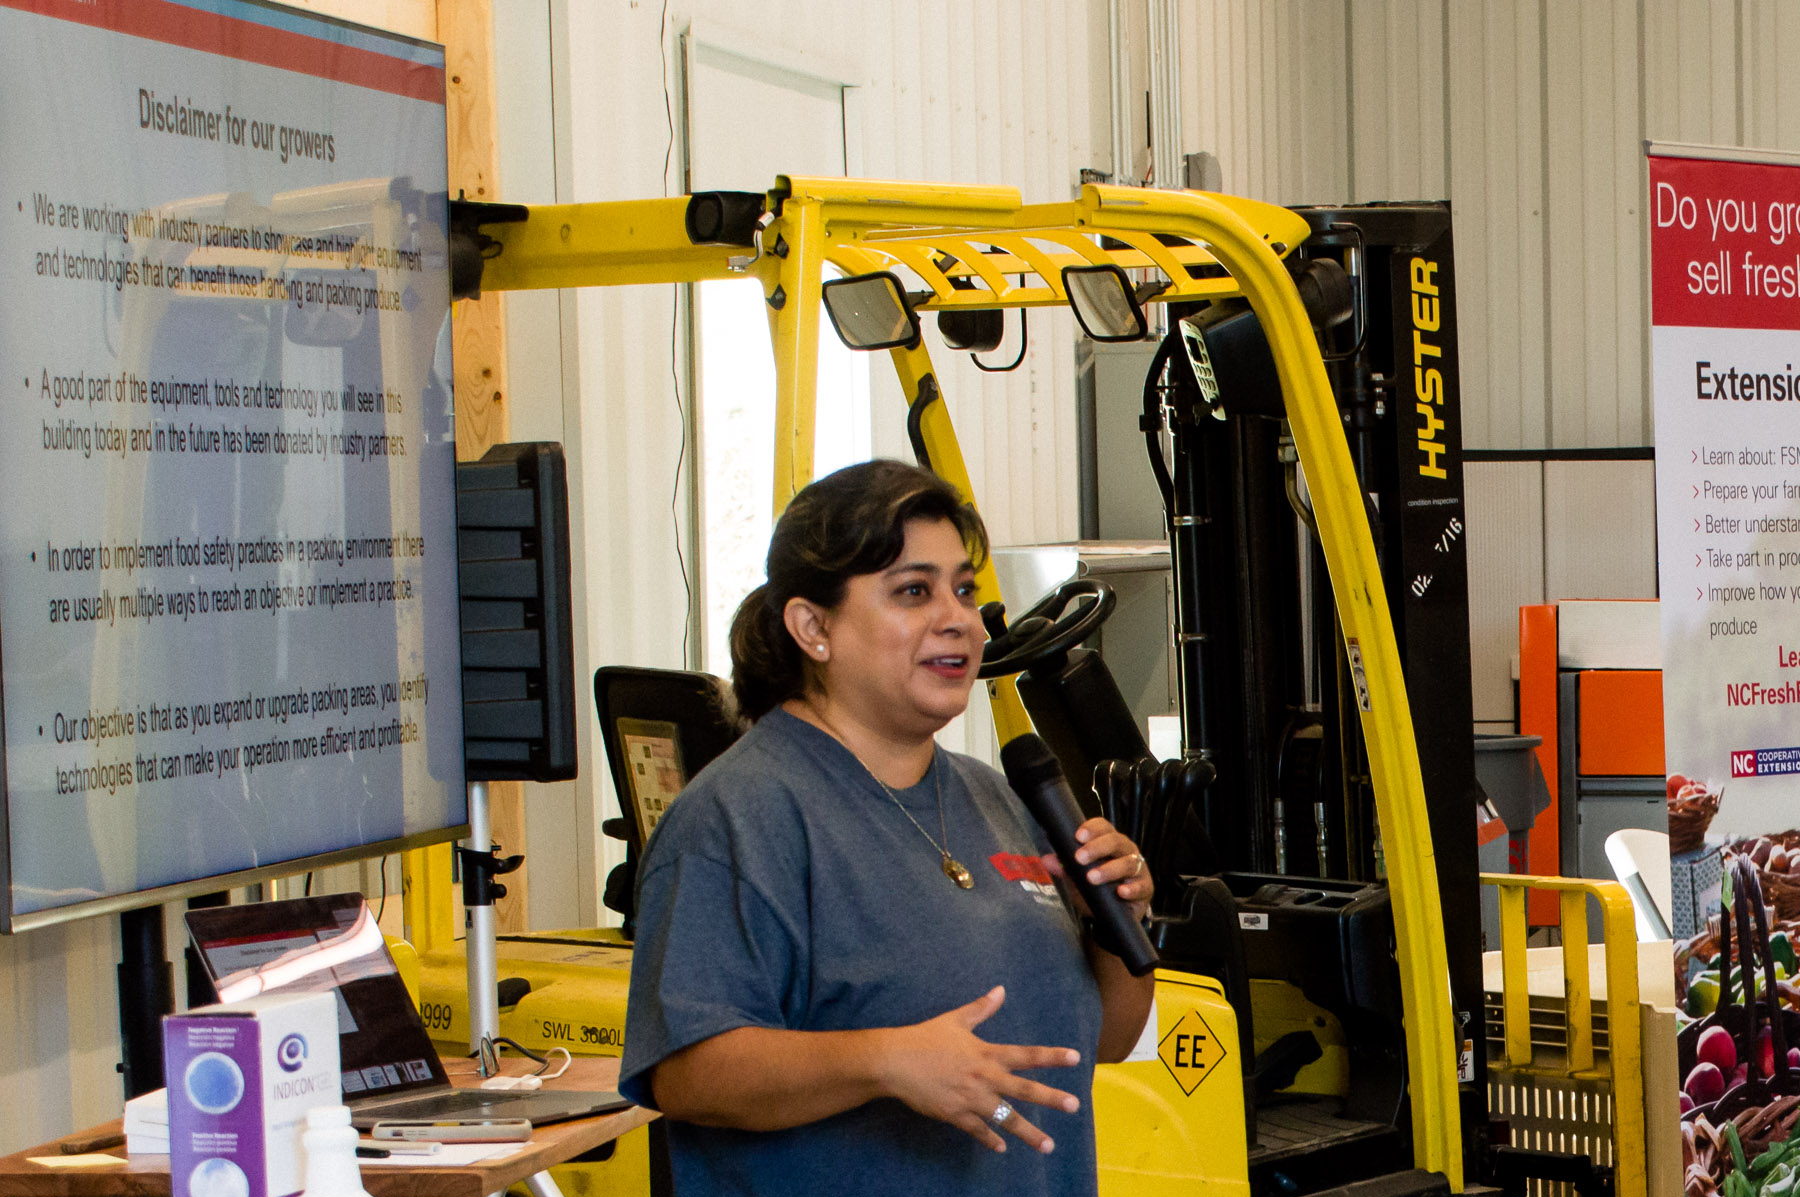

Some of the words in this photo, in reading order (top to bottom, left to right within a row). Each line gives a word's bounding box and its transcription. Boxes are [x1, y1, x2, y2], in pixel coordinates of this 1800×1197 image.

[139, 88, 222, 142] Disclaimer
[226, 105, 246, 146] for
[251, 120, 275, 151] our
[279, 125, 336, 164] growers
[33, 192, 55, 226] We
[59, 205, 79, 230] are
[83, 202, 129, 244] working
[132, 207, 156, 239] with
[205, 219, 249, 256] partners
[251, 223, 262, 251] to
[316, 234, 334, 261] and
[376, 244, 423, 273] equipment
[1656, 182, 1697, 230] Do
[1706, 198, 1757, 242] you
[36, 246, 60, 278] and
[63, 248, 140, 292] technologies
[142, 255, 165, 289] that
[167, 265, 187, 291] can
[189, 265, 227, 295] benefit
[229, 266, 258, 297] those
[260, 269, 303, 309] handling
[306, 276, 323, 306] and
[326, 279, 362, 315] packing
[1687, 250, 1732, 295] sell
[1410, 256, 1447, 480] HYSTER
[41, 367, 51, 401] A
[53, 370, 85, 409] good
[88, 373, 111, 409] part
[115, 372, 127, 403] of
[129, 372, 148, 404] the
[151, 375, 212, 412] equipment,
[215, 377, 240, 407] tools
[243, 380, 262, 409] and
[264, 381, 318, 418] technology
[321, 390, 339, 418] you
[340, 384, 356, 412] will
[357, 391, 374, 413] see
[376, 385, 385, 414] in
[386, 385, 402, 414] this
[42, 418, 91, 460] building
[95, 421, 128, 460] today
[131, 421, 152, 452] and
[154, 422, 166, 452] in
[168, 422, 187, 452] the
[189, 422, 220, 454] future
[223, 424, 243, 454] has
[244, 424, 271, 454] been
[273, 425, 314, 456] donated
[316, 427, 328, 462] by
[330, 427, 366, 462] industry
[1702, 446, 1735, 466] Learn
[1738, 446, 1776, 466] about:
[1703, 480, 1748, 503] Prepare
[1752, 484, 1778, 502] your
[1705, 514, 1740, 533] Better
[48, 540, 60, 573] In
[63, 540, 96, 572] order
[99, 540, 111, 570] to
[114, 537, 174, 577] implement
[176, 536, 201, 567] food
[203, 535, 236, 573] safety
[238, 535, 284, 572] practices
[286, 534, 295, 562] in
[298, 540, 305, 563] a
[307, 533, 344, 568] packing
[346, 531, 401, 560] environment
[402, 530, 425, 557] there
[1706, 548, 1733, 568] Take
[1736, 551, 1760, 570] part
[1763, 549, 1775, 567] in
[50, 597, 70, 624] are
[74, 588, 116, 628] usually
[119, 585, 164, 625] multiple
[166, 591, 196, 623] ways
[198, 585, 209, 614] to
[211, 582, 242, 613] reach
[244, 586, 258, 610] an
[260, 579, 305, 617] objective
[307, 583, 317, 606] or
[319, 576, 368, 610] implement
[369, 580, 376, 602] a
[1708, 583, 1756, 606] Improve
[1759, 581, 1787, 601] how
[1709, 616, 1758, 640] produce
[55, 711, 77, 744] Our
[81, 706, 134, 748] objective
[137, 703, 148, 734] is
[150, 701, 173, 733] that
[175, 706, 188, 729] as
[190, 702, 211, 735] you
[214, 691, 253, 730] expand
[255, 696, 266, 719] or
[268, 686, 309, 724] upgrade
[311, 682, 348, 721] packing
[380, 682, 397, 711] you
[56, 756, 133, 796] technologies
[135, 751, 158, 784] that
[160, 754, 182, 780] can
[184, 744, 214, 777] make
[216, 746, 241, 780] your
[243, 735, 291, 774] operation
[293, 735, 318, 760] more
[320, 726, 357, 757] efficient
[358, 720, 376, 752] and
[1733, 753, 1754, 775] NC
[542, 1020, 575, 1042] SWL
[1174, 1033, 1207, 1069] EE
[273, 1076, 315, 1100] INDICON
